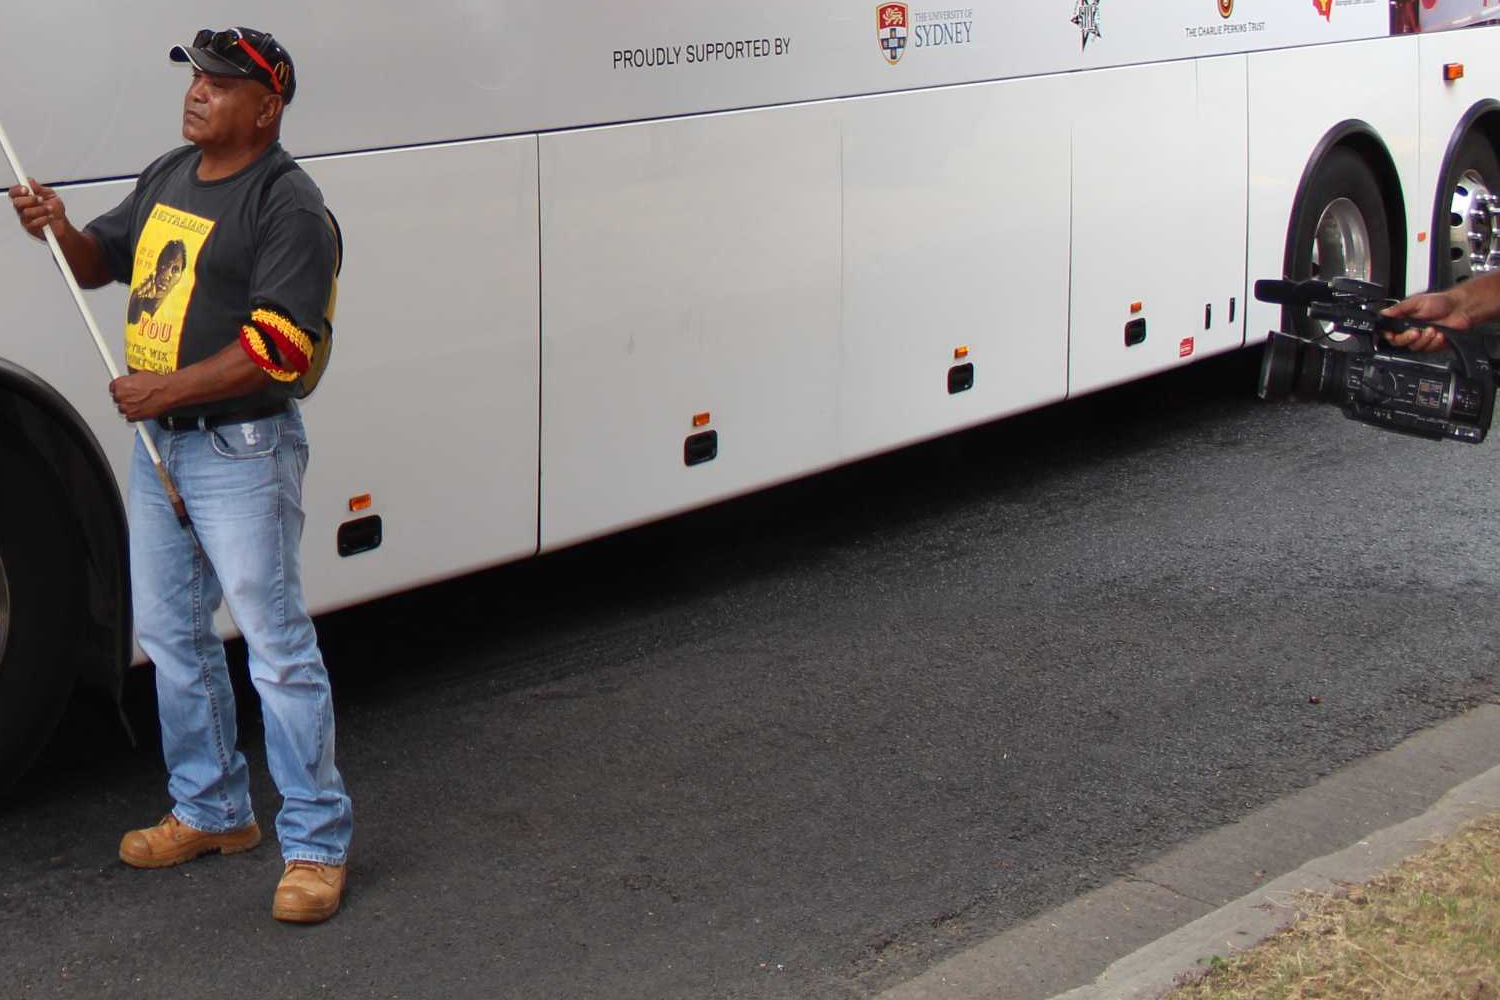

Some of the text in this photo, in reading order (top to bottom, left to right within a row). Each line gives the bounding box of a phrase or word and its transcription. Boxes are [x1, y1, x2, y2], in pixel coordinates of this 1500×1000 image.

[914, 21, 973, 48] SYDNEY
[613, 37, 791, 69] PROUDLY SUPPORTED BY
[138, 315, 173, 343] YOU
